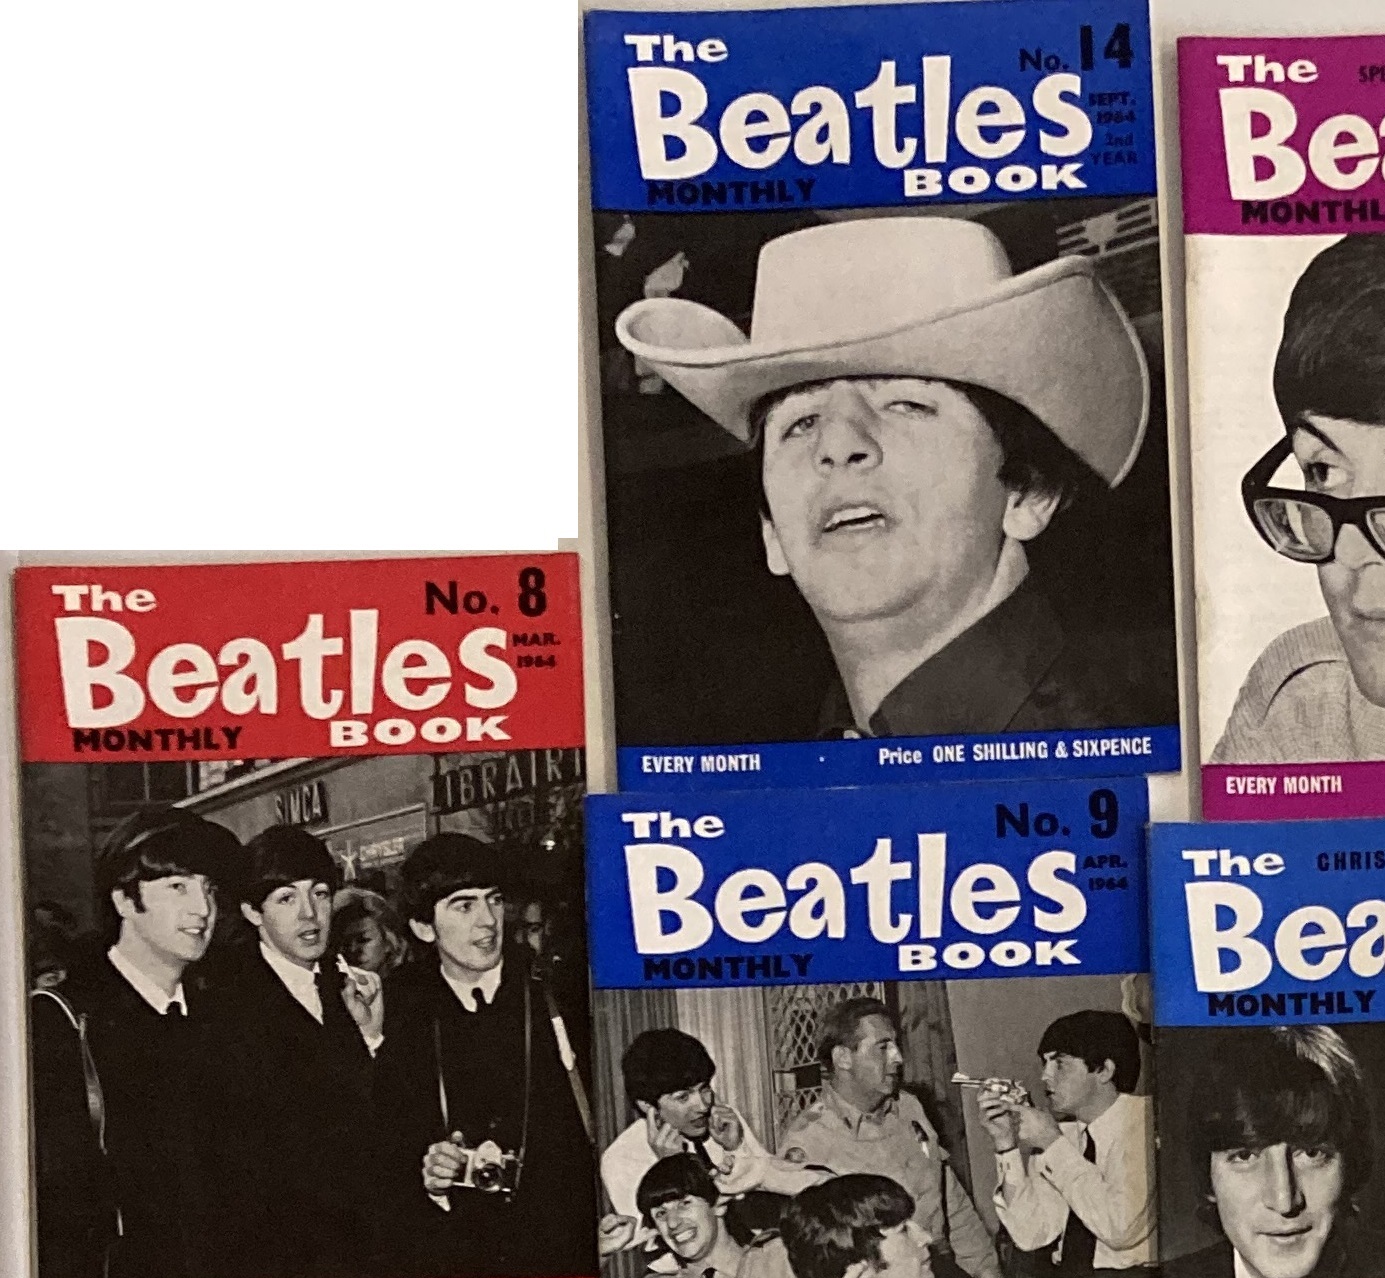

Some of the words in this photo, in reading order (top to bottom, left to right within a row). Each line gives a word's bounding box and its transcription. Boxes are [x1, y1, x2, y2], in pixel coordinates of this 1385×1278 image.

[624, 34, 728, 63] The
[1216, 55, 1319, 83] The
[627, 55, 1092, 180] Beatles
[903, 163, 1087, 197] BOOK
[52, 584, 157, 612] The
[425, 581, 499, 615] No.
[518, 567, 547, 617] 8
[54, 609, 518, 729] Beatles
[330, 715, 511, 748] BOOK
[622, 812, 725, 839] The
[1182, 850, 1286, 876] The
[624, 832, 1087, 955] Beatles
[899, 940, 1081, 972] BOOK
